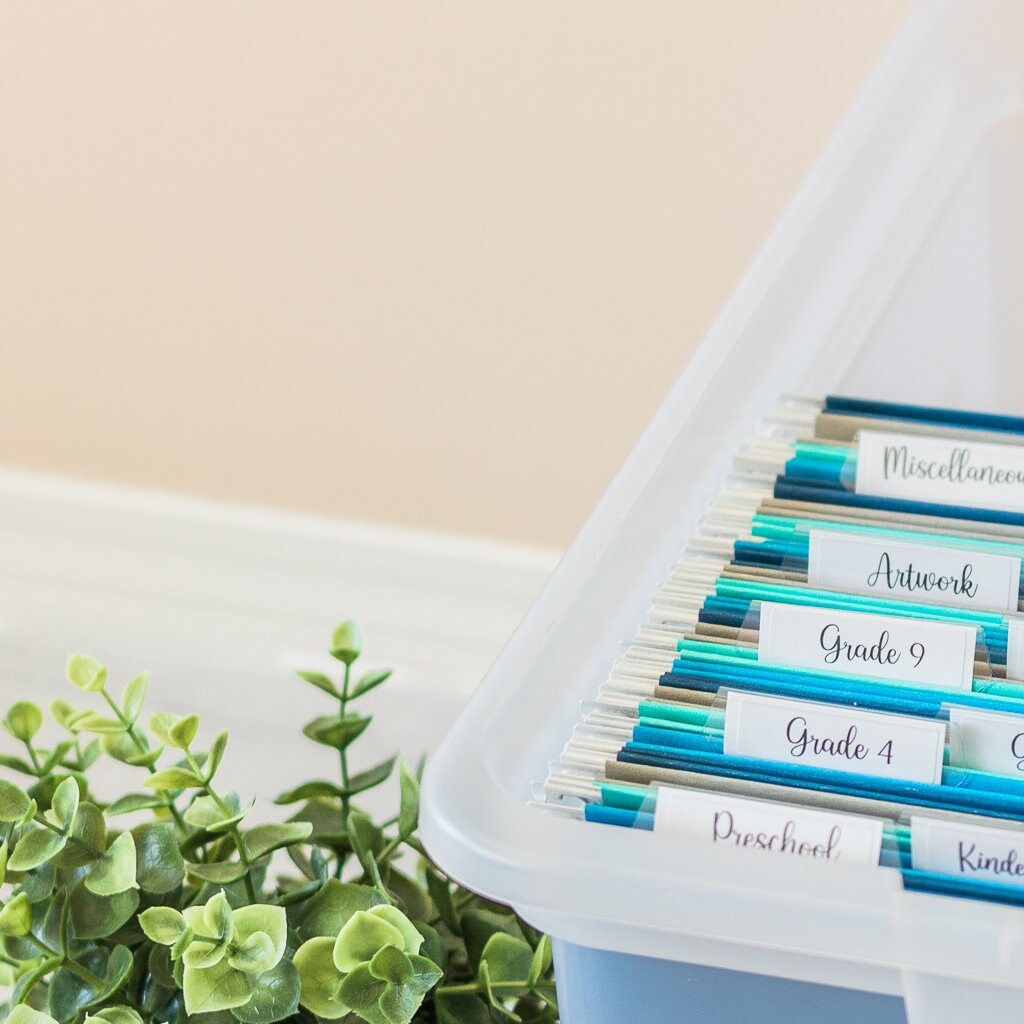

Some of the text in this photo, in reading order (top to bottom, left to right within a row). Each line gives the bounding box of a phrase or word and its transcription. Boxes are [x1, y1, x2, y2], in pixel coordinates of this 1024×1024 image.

[867, 552, 978, 598] Artwork
[820, 624, 925, 668] Grade 9
[786, 717, 893, 764] Grade 4
